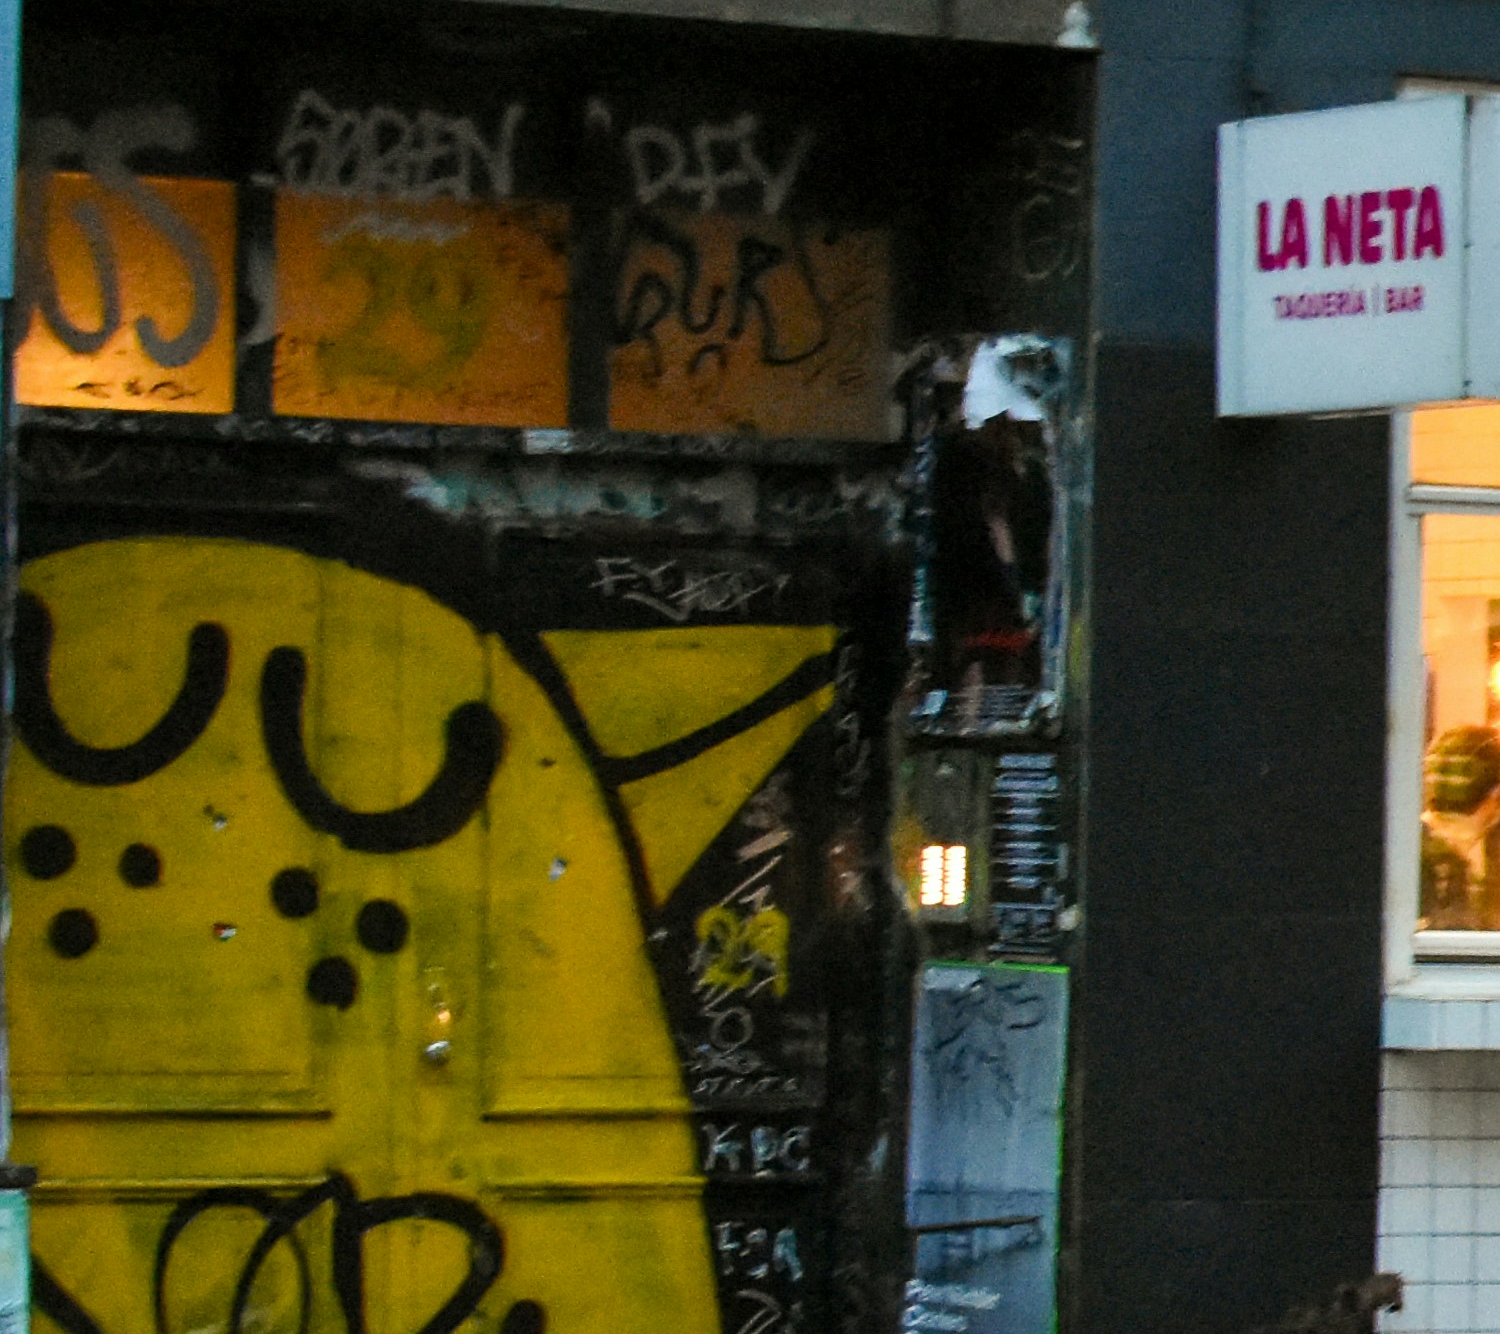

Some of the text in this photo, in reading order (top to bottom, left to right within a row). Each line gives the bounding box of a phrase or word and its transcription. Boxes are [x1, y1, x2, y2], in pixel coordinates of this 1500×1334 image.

[1257, 184, 1445, 272] LA NETA
[1386, 284, 1425, 315] BAR
